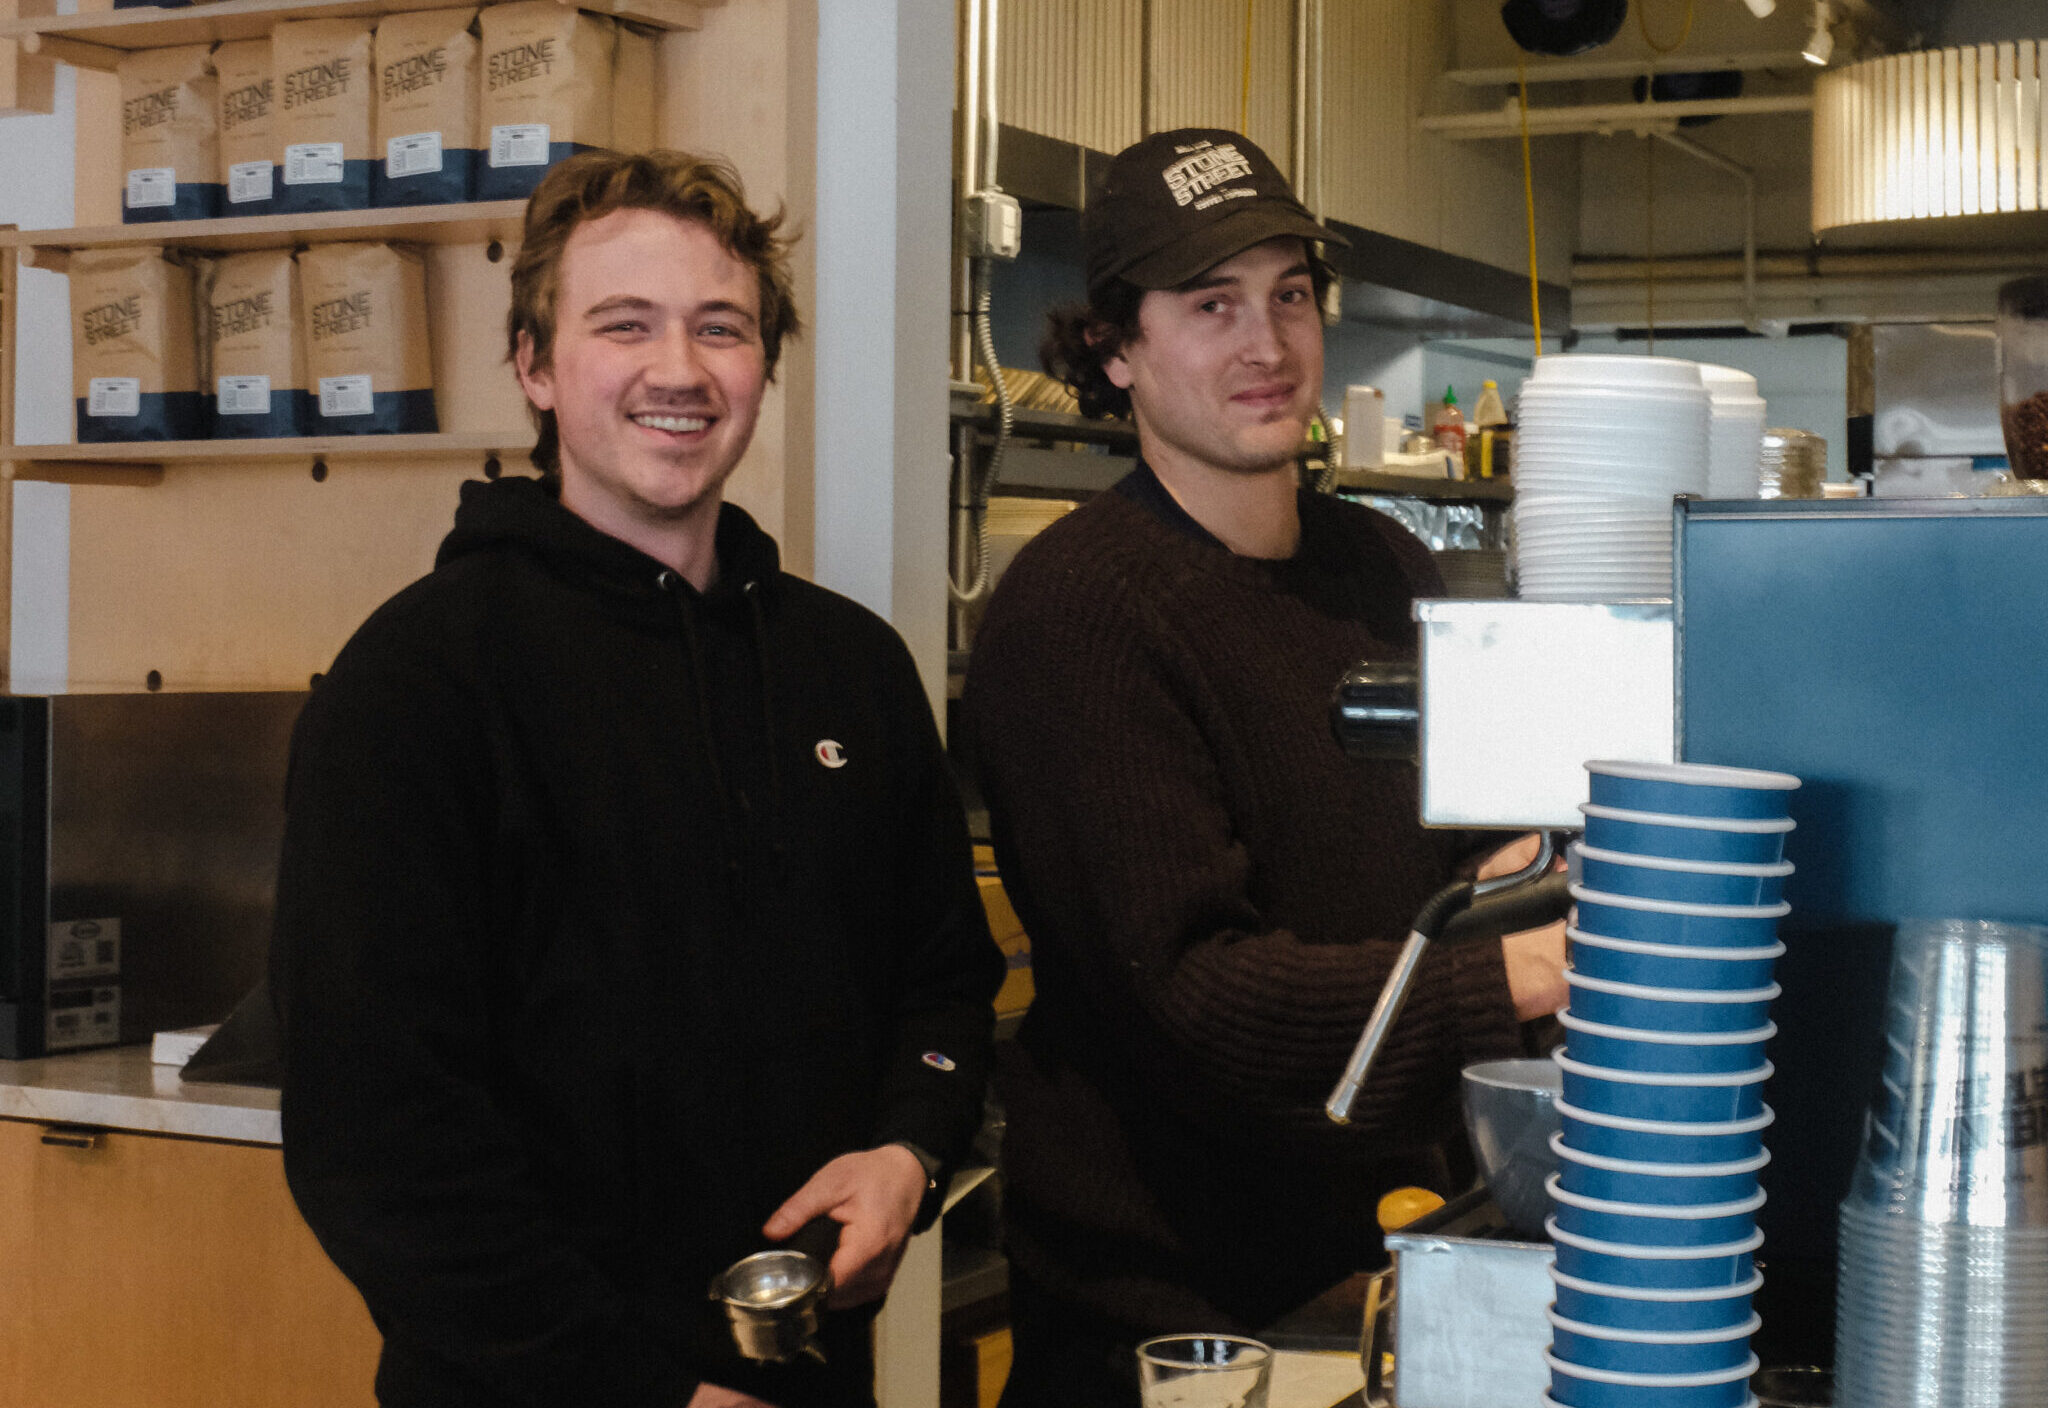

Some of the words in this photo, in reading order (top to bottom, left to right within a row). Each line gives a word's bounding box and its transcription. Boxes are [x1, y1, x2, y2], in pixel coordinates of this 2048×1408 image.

[384, 47, 448, 86] STONE
[489, 38, 556, 75] STONE
[284, 57, 351, 93] STONE
[383, 68, 447, 102] STREET
[488, 60, 556, 91] STREET
[124, 86, 179, 119] STONE
[283, 78, 351, 110] STREET
[1162, 144, 1247, 190] STONE
[1171, 160, 1253, 206] STREET
[83, 295, 142, 330] STONE
[214, 291, 274, 323] STONE
[312, 290, 373, 324] STONE
[313, 310, 373, 341] STREET
